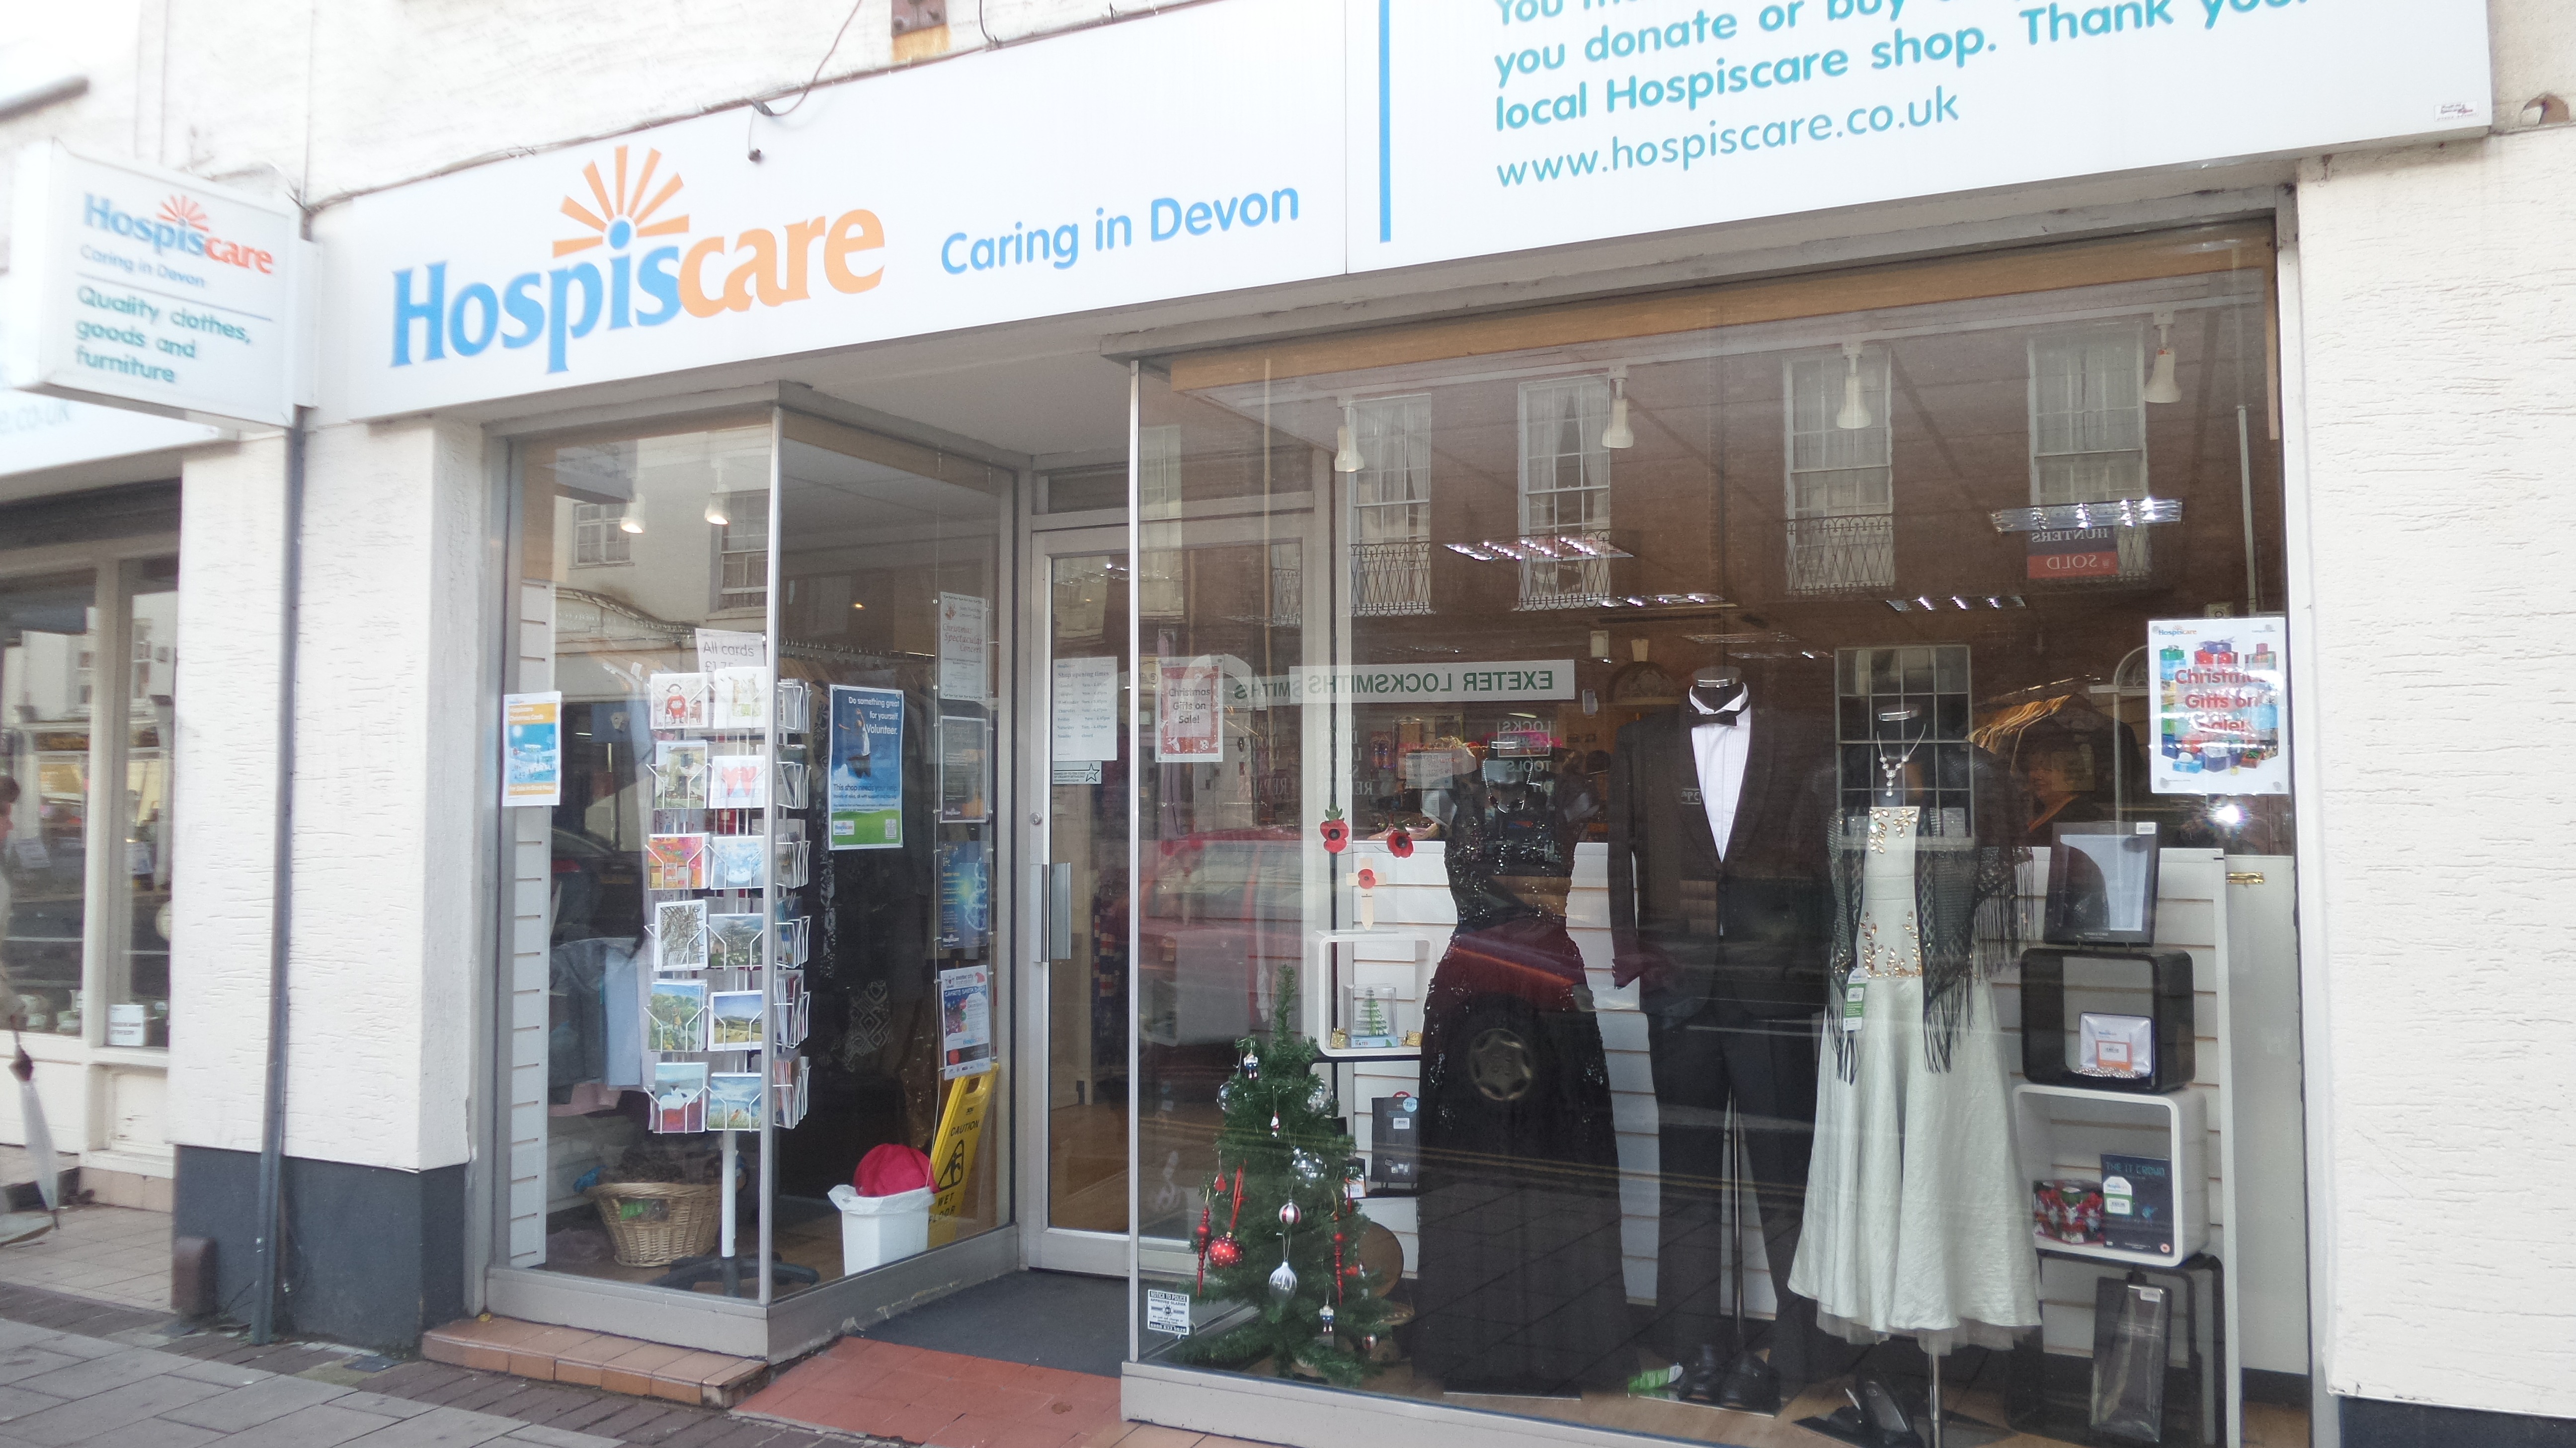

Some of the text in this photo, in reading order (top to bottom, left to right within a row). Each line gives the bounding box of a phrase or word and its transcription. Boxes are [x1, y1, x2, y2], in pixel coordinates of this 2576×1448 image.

[1494, 42, 1566, 88] you
[1584, 8, 1738, 63] donate
[1758, 0, 1805, 32] or
[1495, 80, 1587, 132] local
[1606, 49, 1849, 111] Hospiscare
[1870, 27, 1997, 69] shop.
[2018, 0, 2174, 46] Thank
[1495, 85, 1959, 188] www.hospiscare.co.uk
[83, 193, 273, 274] Hospiscare
[941, 187, 1299, 275] Caring in Devon
[80, 243, 206, 289] Caring in Devon
[390, 208, 886, 374] Hospiscare
[77, 285, 252, 345] Quality clothes,
[75, 320, 196, 360] goods and
[75, 345, 175, 384] furniture
[703, 641, 754, 656] All cards
[848, 696, 900, 709] Do something great
[1169, 688, 1210, 697] Christmas
[866, 724, 898, 735] Volunteer.
[878, 712, 899, 721] yourself.
[1178, 714, 1200, 724] Sale!
[844, 784, 858, 792] shop
[950, 1119, 980, 1136] CAUTION
[938, 1193, 955, 1207] WET
